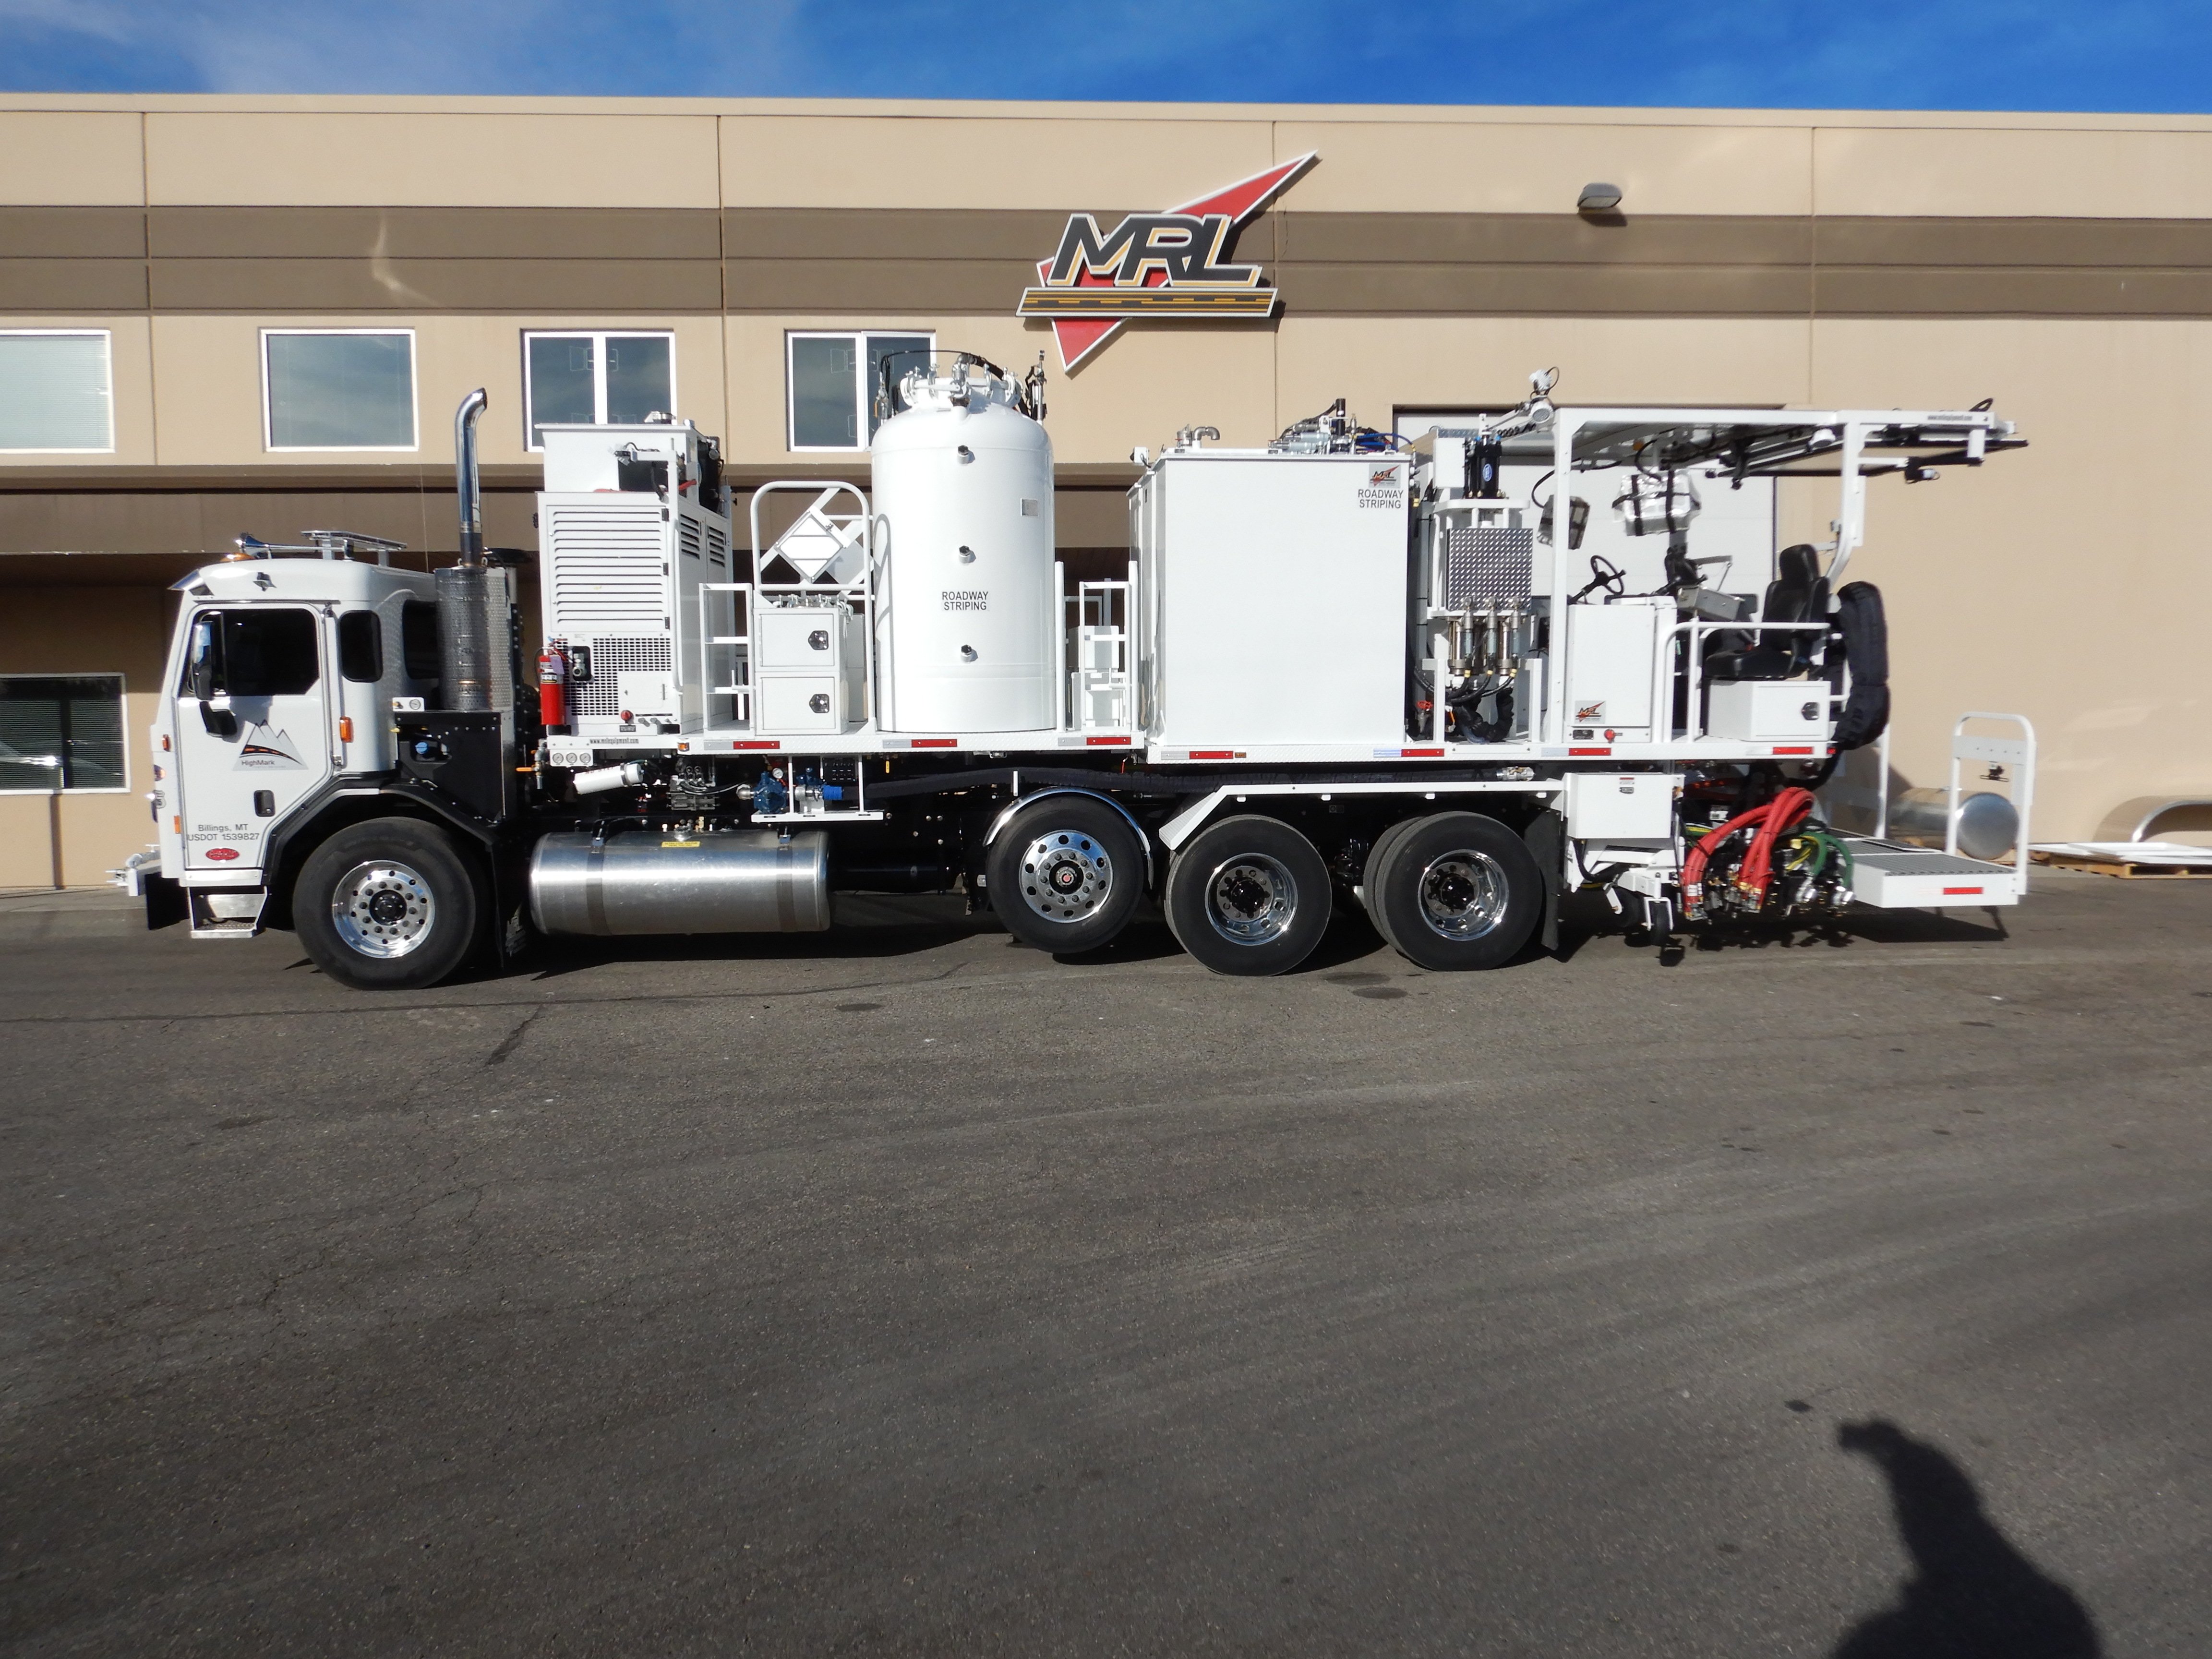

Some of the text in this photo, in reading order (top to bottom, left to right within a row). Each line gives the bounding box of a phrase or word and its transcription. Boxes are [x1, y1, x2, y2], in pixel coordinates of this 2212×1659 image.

[1047, 213, 1263, 287] MRL
[1358, 489, 1403, 498] ROADWAY
[1359, 499, 1401, 509] STRIPING
[942, 591, 988, 600] ROADWAY
[944, 601, 986, 611] STRIPING
